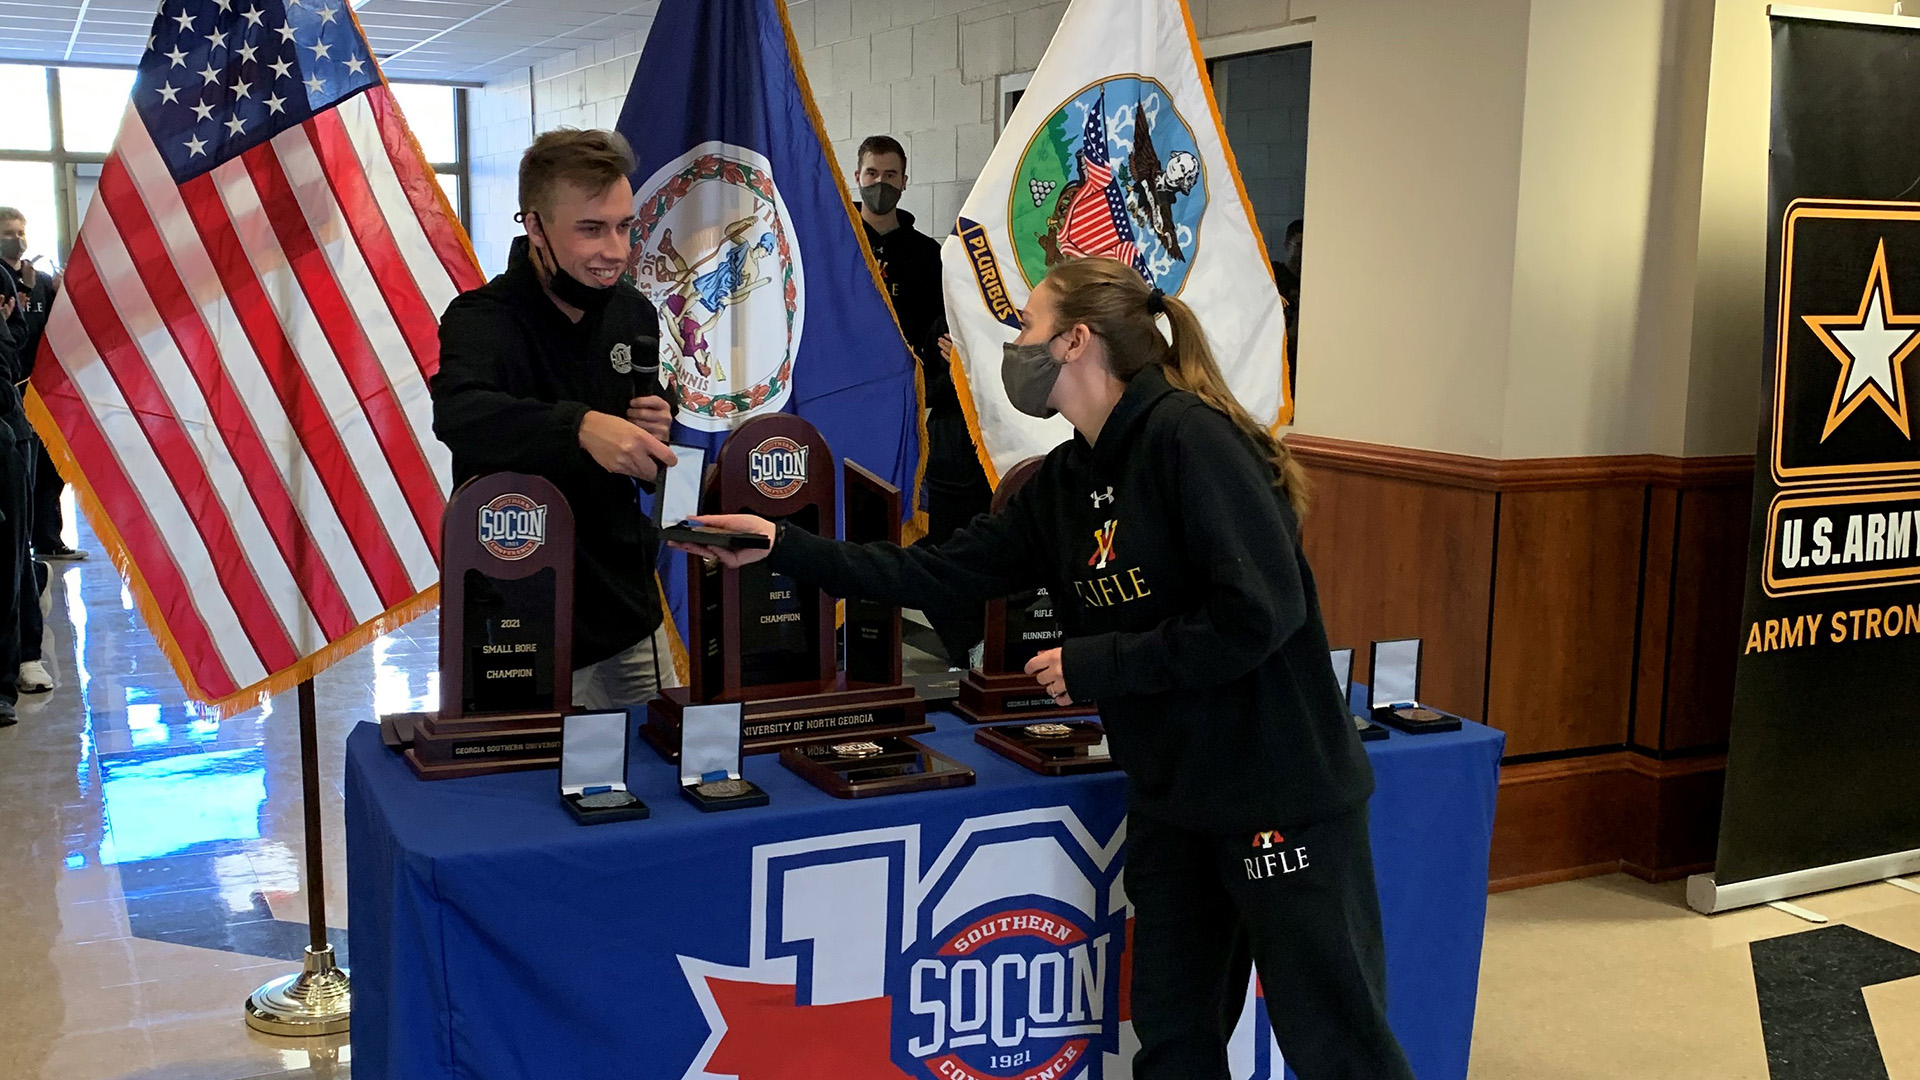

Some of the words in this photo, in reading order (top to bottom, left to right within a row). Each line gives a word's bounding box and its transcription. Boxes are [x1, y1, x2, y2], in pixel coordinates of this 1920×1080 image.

[642, 252, 655, 276] SIC
[969, 236, 1013, 320] PLURIBUS
[752, 449, 806, 483] SOCON
[481, 508, 544, 542] SOCON
[769, 591, 791, 600] RIFLE
[501, 619, 520, 628] 2021
[760, 613, 801, 624] CHAMPION
[1034, 609, 1054, 618] RIFLE
[1744, 614, 1823, 655] ARMY
[483, 645, 513, 654] SMALL
[515, 644, 537, 653] BORE
[486, 668, 533, 679] CHAMPION
[743, 722, 792, 737] NIVERSITY
[793, 721, 805, 731] OF
[806, 717, 837, 729] NORTH
[837, 713, 874, 726] GEORGIA
[455, 746, 486, 755] GEORGIA
[486, 743, 524, 753] SOUTHERN
[1243, 846, 1310, 880] RIFLE
[954, 915, 1073, 952] SOUTHERN
[908, 933, 1111, 1058] SOCON
[990, 1050, 1032, 1068] 1921
